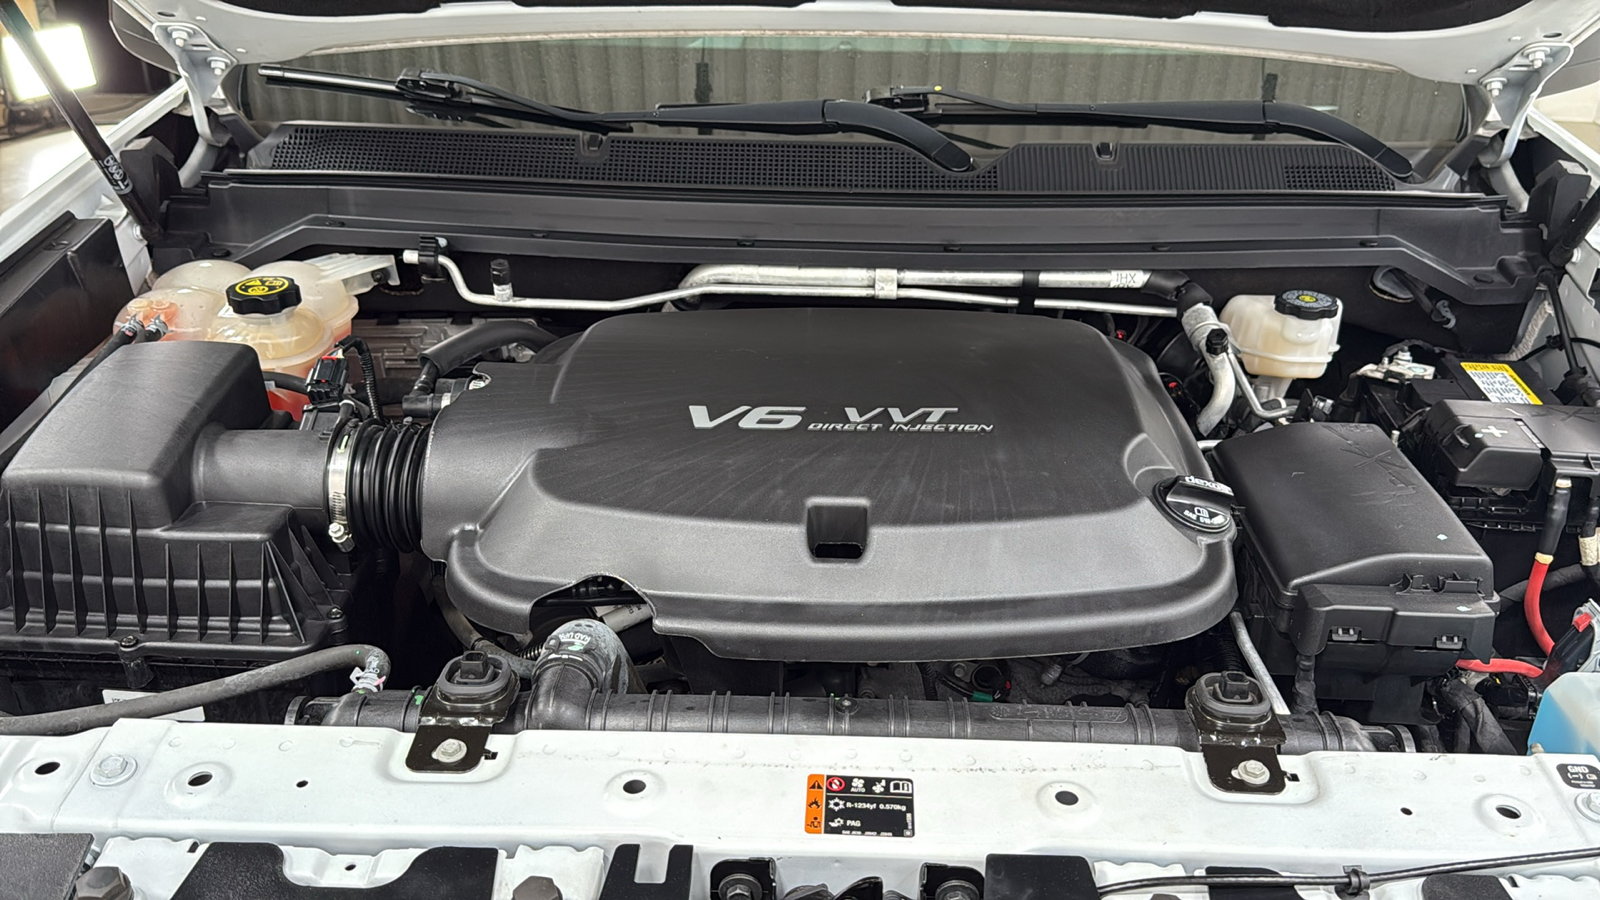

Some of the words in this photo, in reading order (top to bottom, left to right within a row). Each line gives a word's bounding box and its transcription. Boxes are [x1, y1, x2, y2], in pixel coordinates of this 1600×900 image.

[689, 405, 806, 429] V6
[844, 407, 959, 423] VVT
[807, 423, 883, 431] DIRECT
[889, 424, 994, 432] INJECTION
[1567, 765, 1589, 773] GND
[846, 802, 877, 810] R-1234yf
[878, 803, 907, 812] 0.570kg
